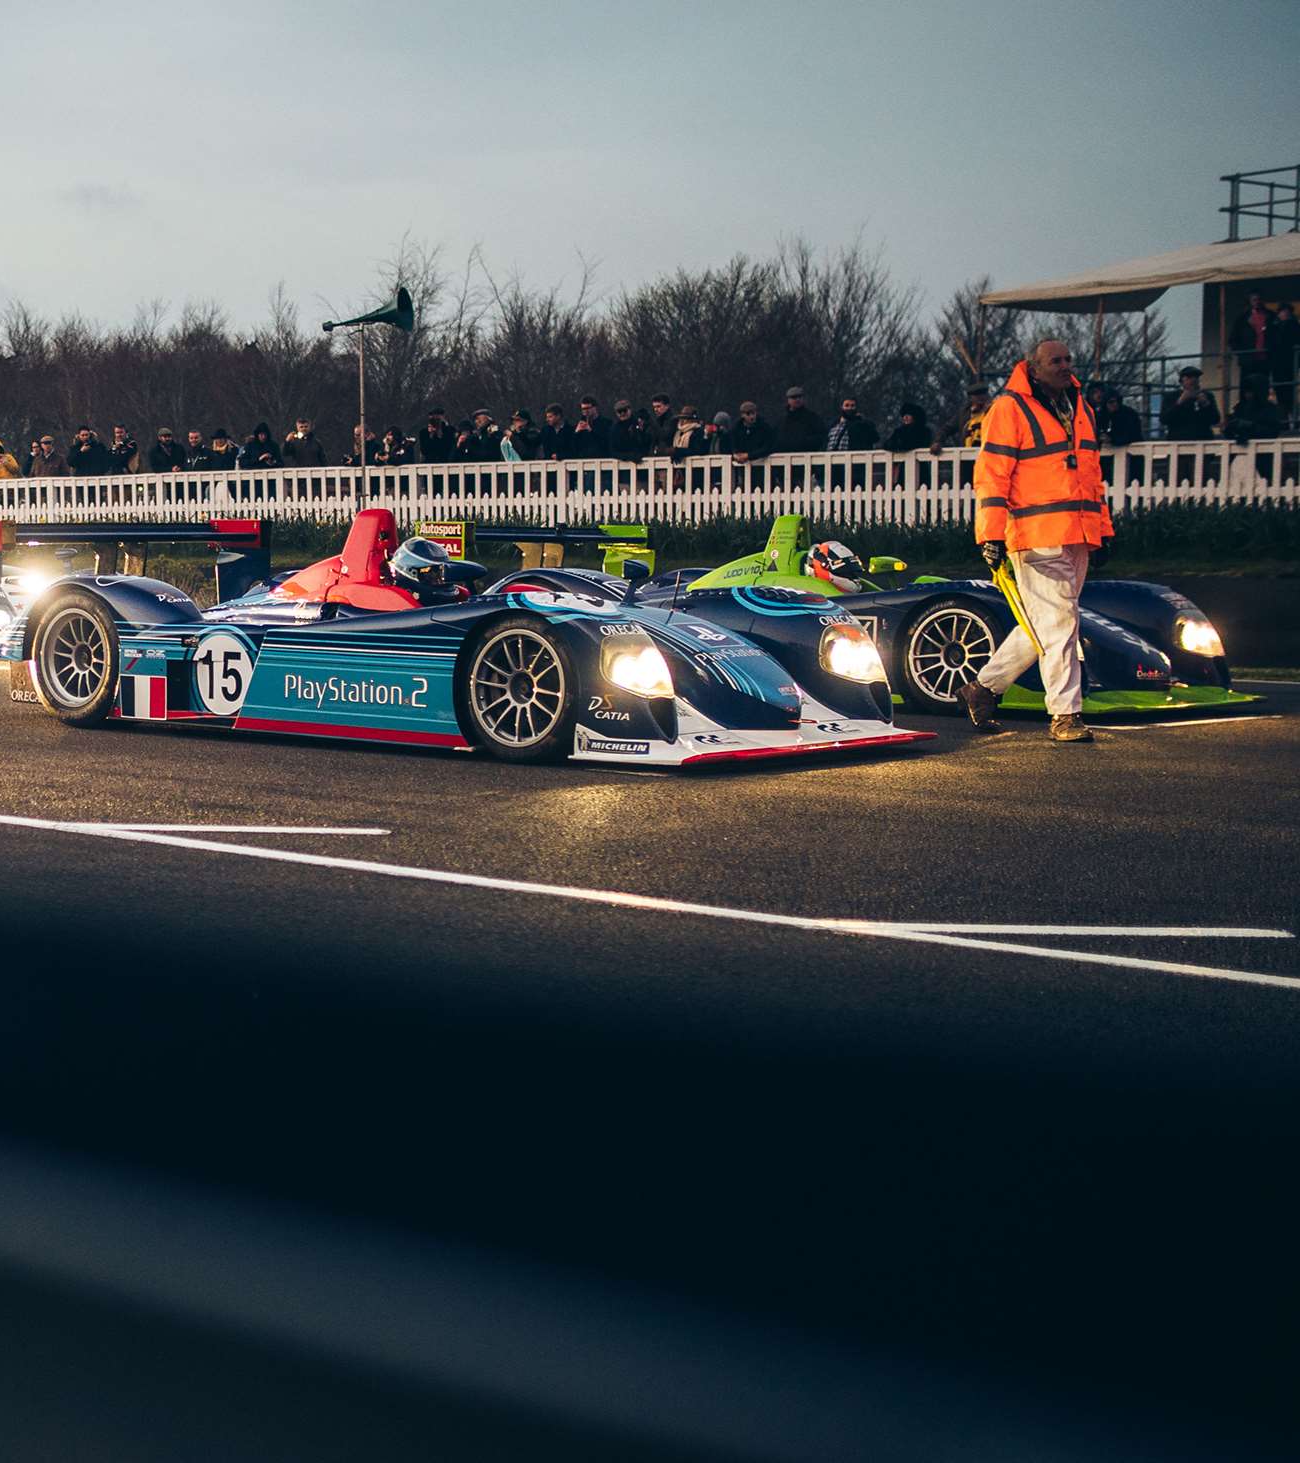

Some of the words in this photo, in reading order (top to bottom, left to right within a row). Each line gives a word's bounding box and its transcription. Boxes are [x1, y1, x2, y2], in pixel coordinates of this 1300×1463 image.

[420, 523, 461, 535] Autosport
[199, 650, 243, 702] 15
[284, 674, 403, 709] PlayStation
[411, 677, 428, 708] 2
[595, 710, 630, 721] CATIA
[591, 742, 648, 752] MICHELIN
